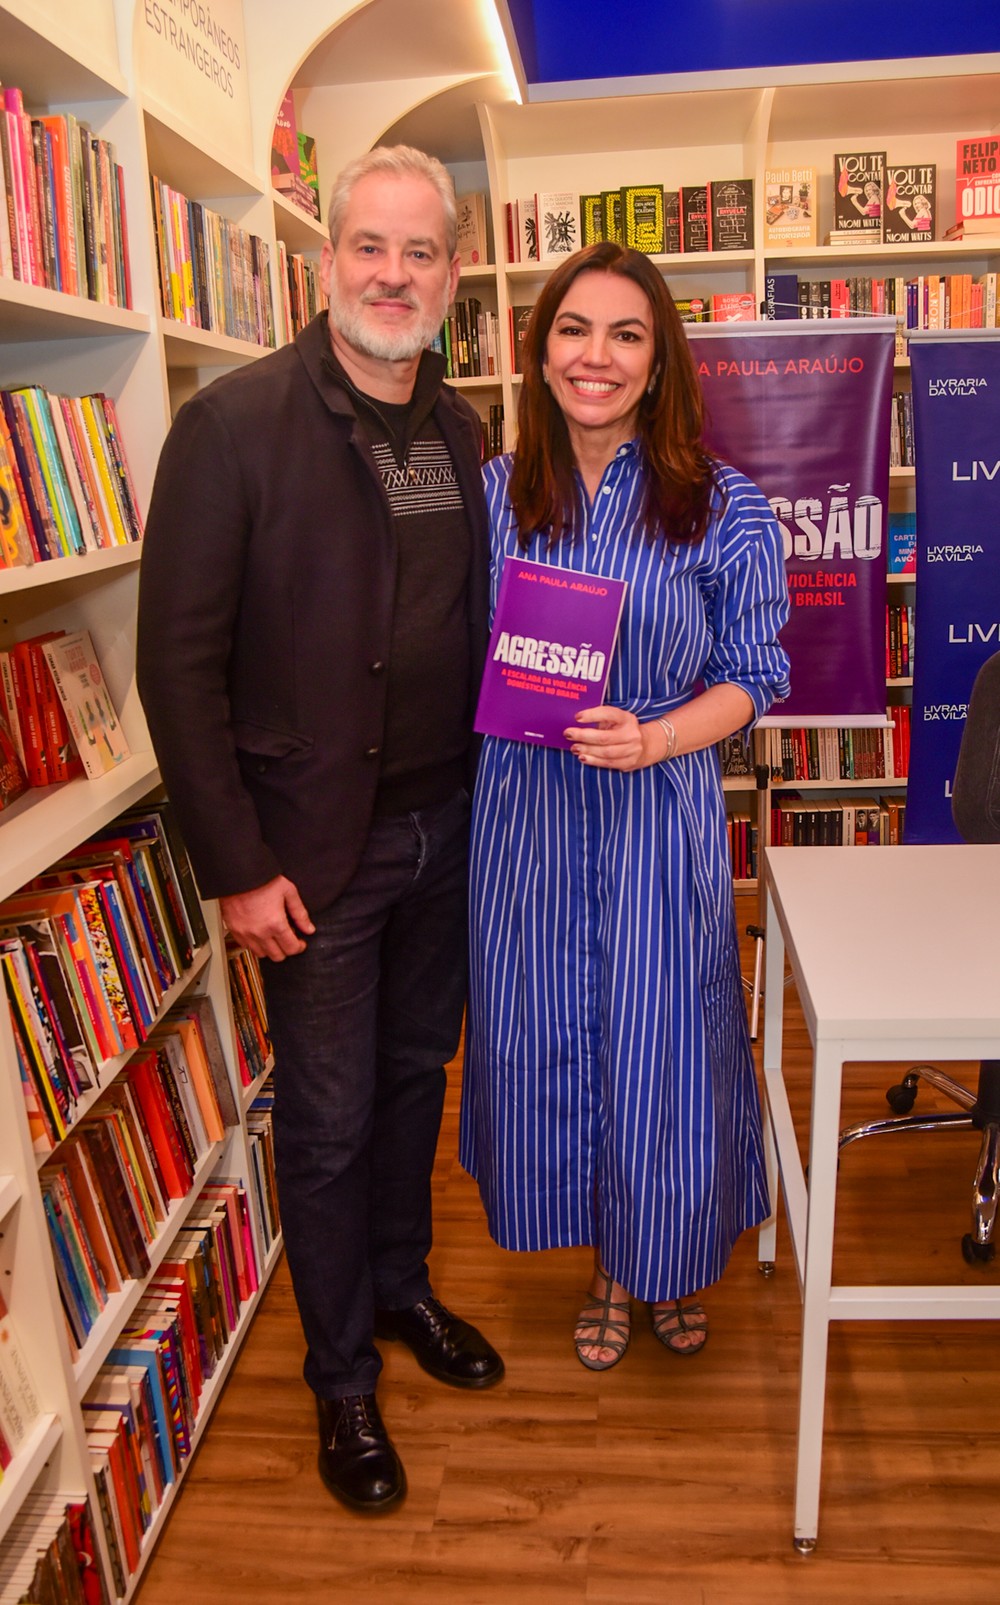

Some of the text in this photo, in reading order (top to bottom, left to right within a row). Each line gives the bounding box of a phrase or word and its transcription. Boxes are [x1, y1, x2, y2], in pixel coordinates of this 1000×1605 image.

[167, 0, 240, 70] PORÂNEOS
[144, 0, 234, 99] ESTRANGEIROS
[963, 141, 1000, 159] FELIP
[838, 156, 867, 172] VOU
[963, 157, 997, 175] NETO
[765, 168, 813, 183] Paulo Betti
[887, 168, 933, 186] VOU TE
[896, 184, 933, 196] CONTAR
[838, 218, 862, 229] NAOMI
[886, 232, 910, 243] NAOMI
[911, 231, 932, 241] WATTS
[717, 360, 779, 377] PAULA
[784, 354, 864, 375] ARAÚJO
[928, 378, 988, 388] LIVRARIA
[928, 386, 977, 397] DA VILA
[927, 545, 984, 554] LIVRARIA
[927, 552, 974, 563] DA VILA
[518, 571, 608, 597] ANA PAULA ARAÚJO
[795, 592, 846, 607] BRASIL
[949, 623, 1000, 643] LIV
[493, 631, 606, 682] AGRESSÃO
[501, 668, 588, 692] A ESCALADA DA VIOLÊNCIA
[506, 678, 580, 700] DOMÉSTICA NO BRASIL
[923, 712, 940, 721] DA
